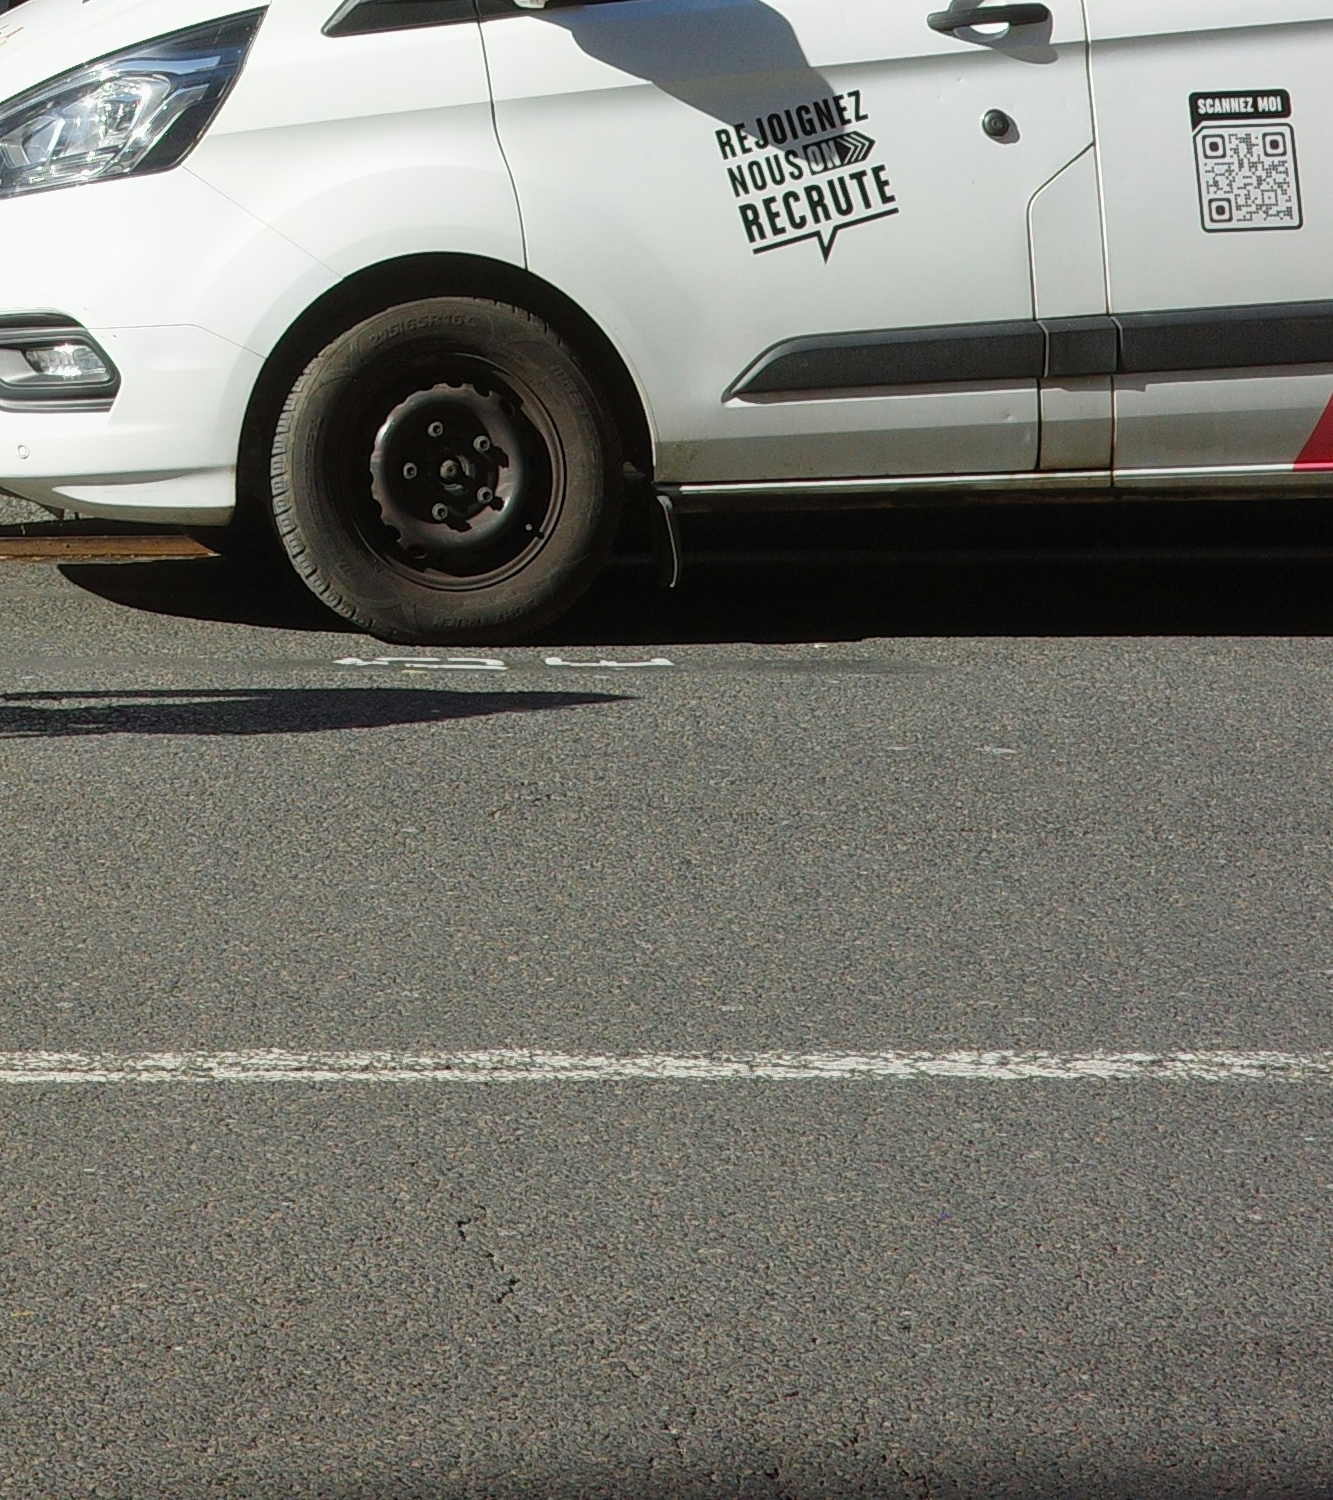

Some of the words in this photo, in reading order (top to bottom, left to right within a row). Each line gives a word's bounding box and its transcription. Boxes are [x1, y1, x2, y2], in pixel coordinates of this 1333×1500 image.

[714, 89, 869, 161] REJOIGNEZ
[1197, 96, 1255, 115] SCANNEZ
[1257, 95, 1283, 113] MOI
[726, 149, 805, 199] NOUS
[806, 140, 841, 174] ON
[738, 164, 897, 244] RECRUTE
